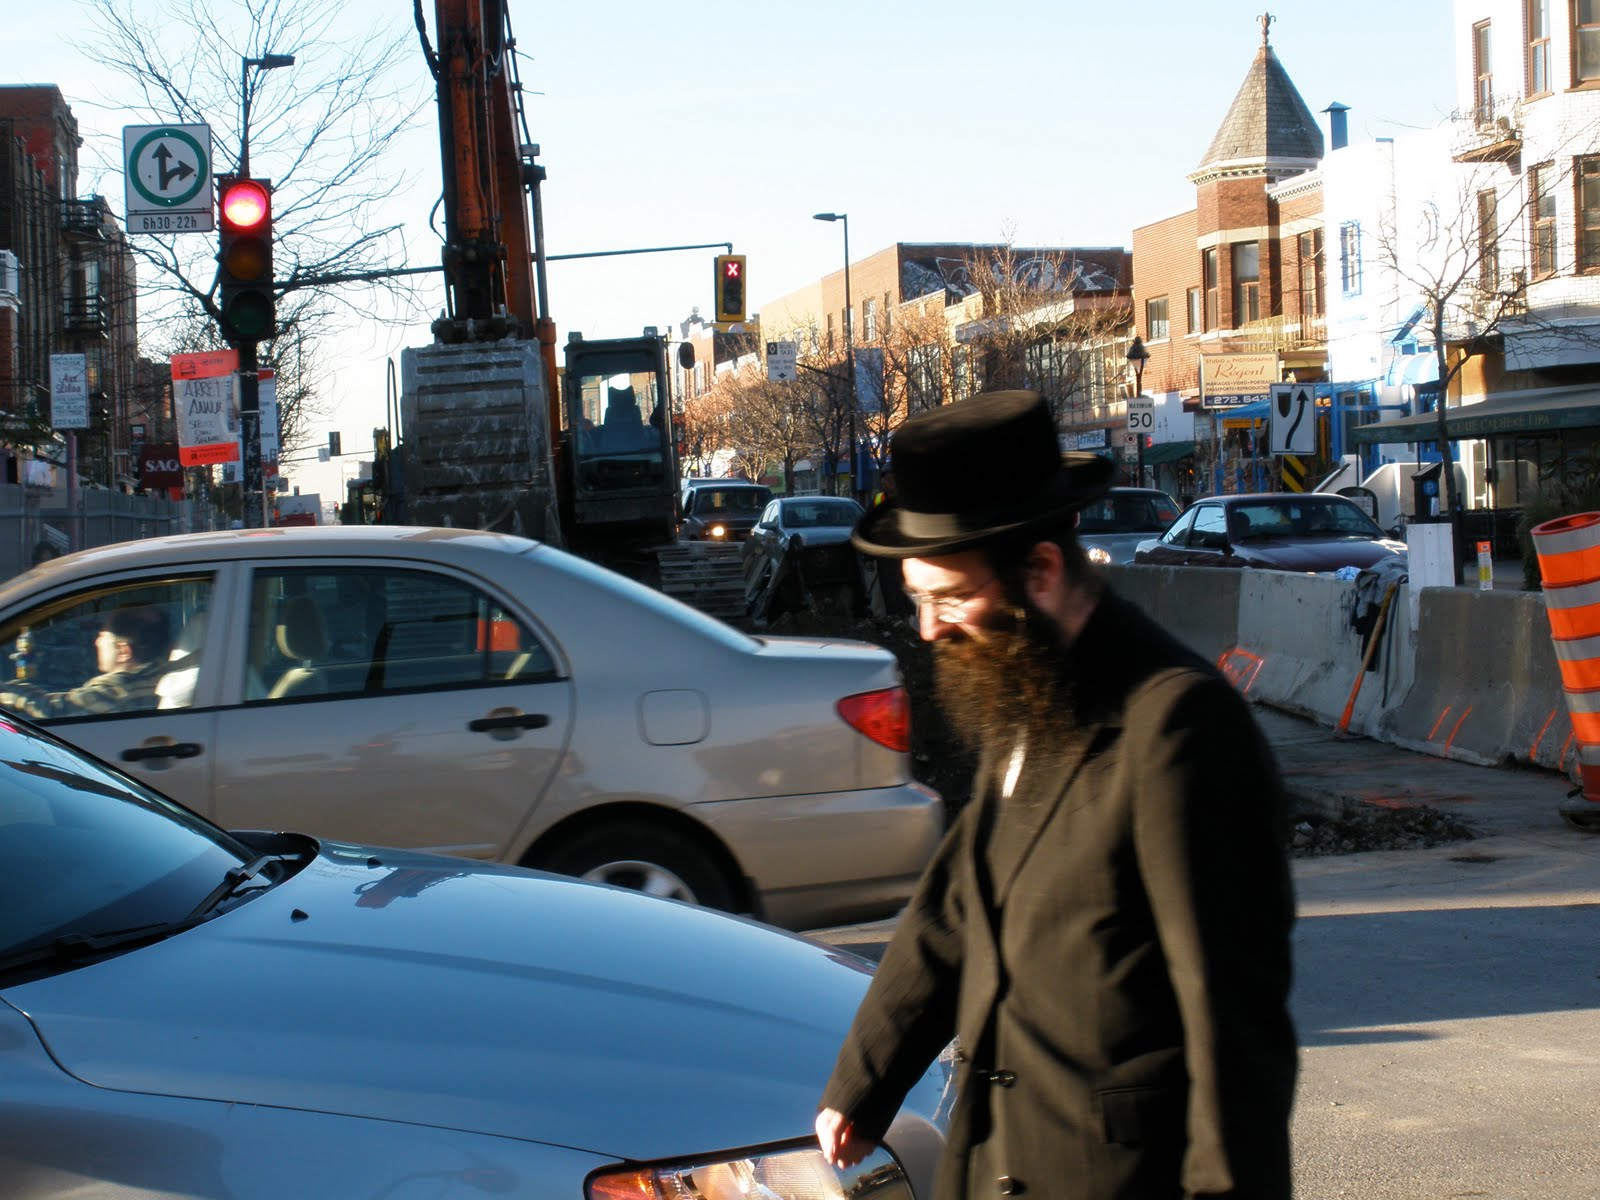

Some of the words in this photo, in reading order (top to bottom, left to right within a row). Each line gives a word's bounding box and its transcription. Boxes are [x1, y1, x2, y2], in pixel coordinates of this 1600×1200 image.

[143, 216, 197, 230] 6h30-22h
[1214, 363, 1265, 379] Régent
[1130, 412, 1152, 428] 50
